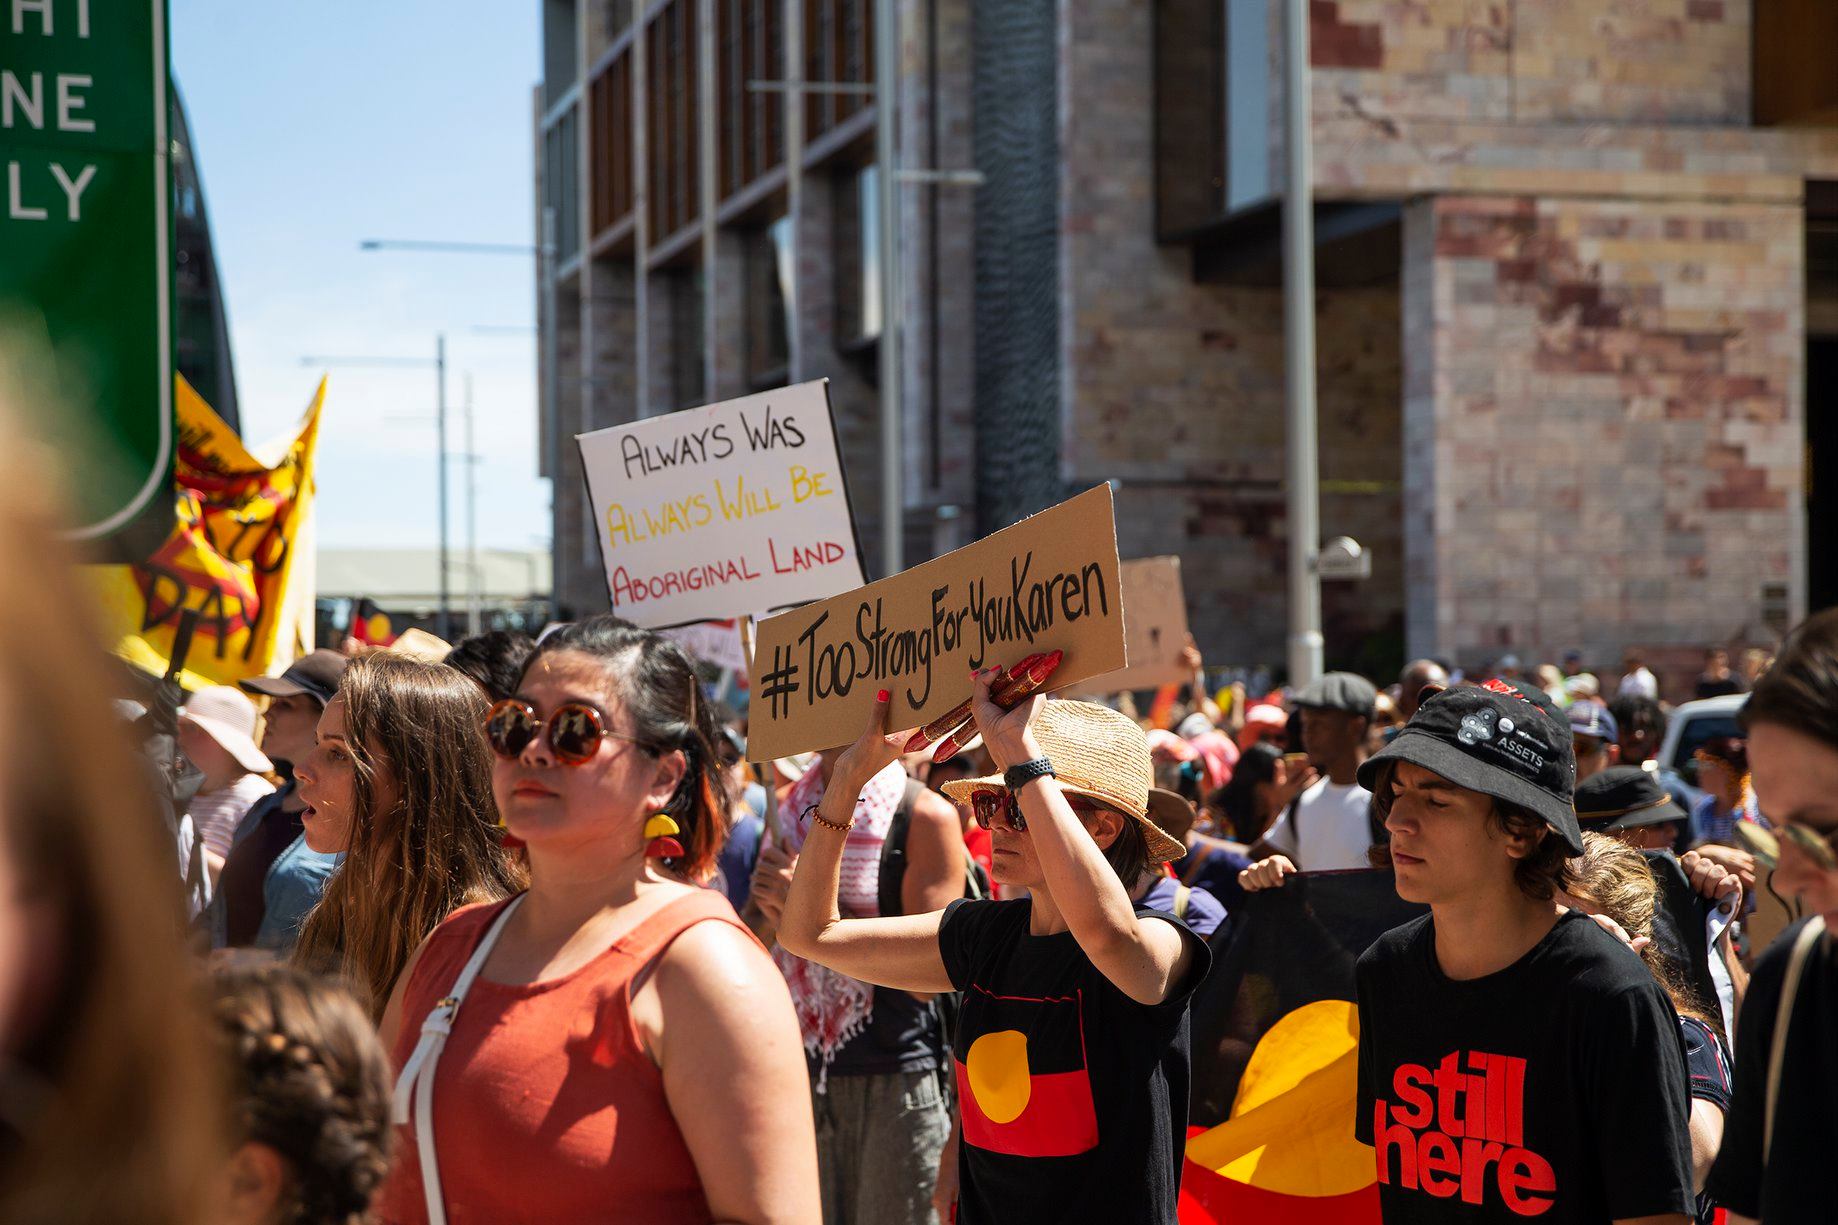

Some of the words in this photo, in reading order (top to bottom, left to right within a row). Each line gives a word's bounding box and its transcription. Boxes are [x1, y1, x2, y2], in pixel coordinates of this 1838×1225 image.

[620, 423, 734, 479] ALWAYS
[740, 404, 806, 452] WAS
[606, 493, 713, 549] ALWAYS
[713, 474, 781, 523] WILL
[789, 464, 833, 504] BE
[612, 556, 761, 607] ABORIGINAL
[768, 537, 845, 574] LAND
[1497, 736, 1544, 768] ASSETS
[1390, 1049, 1527, 1148] still
[1373, 1098, 1557, 1217] here
